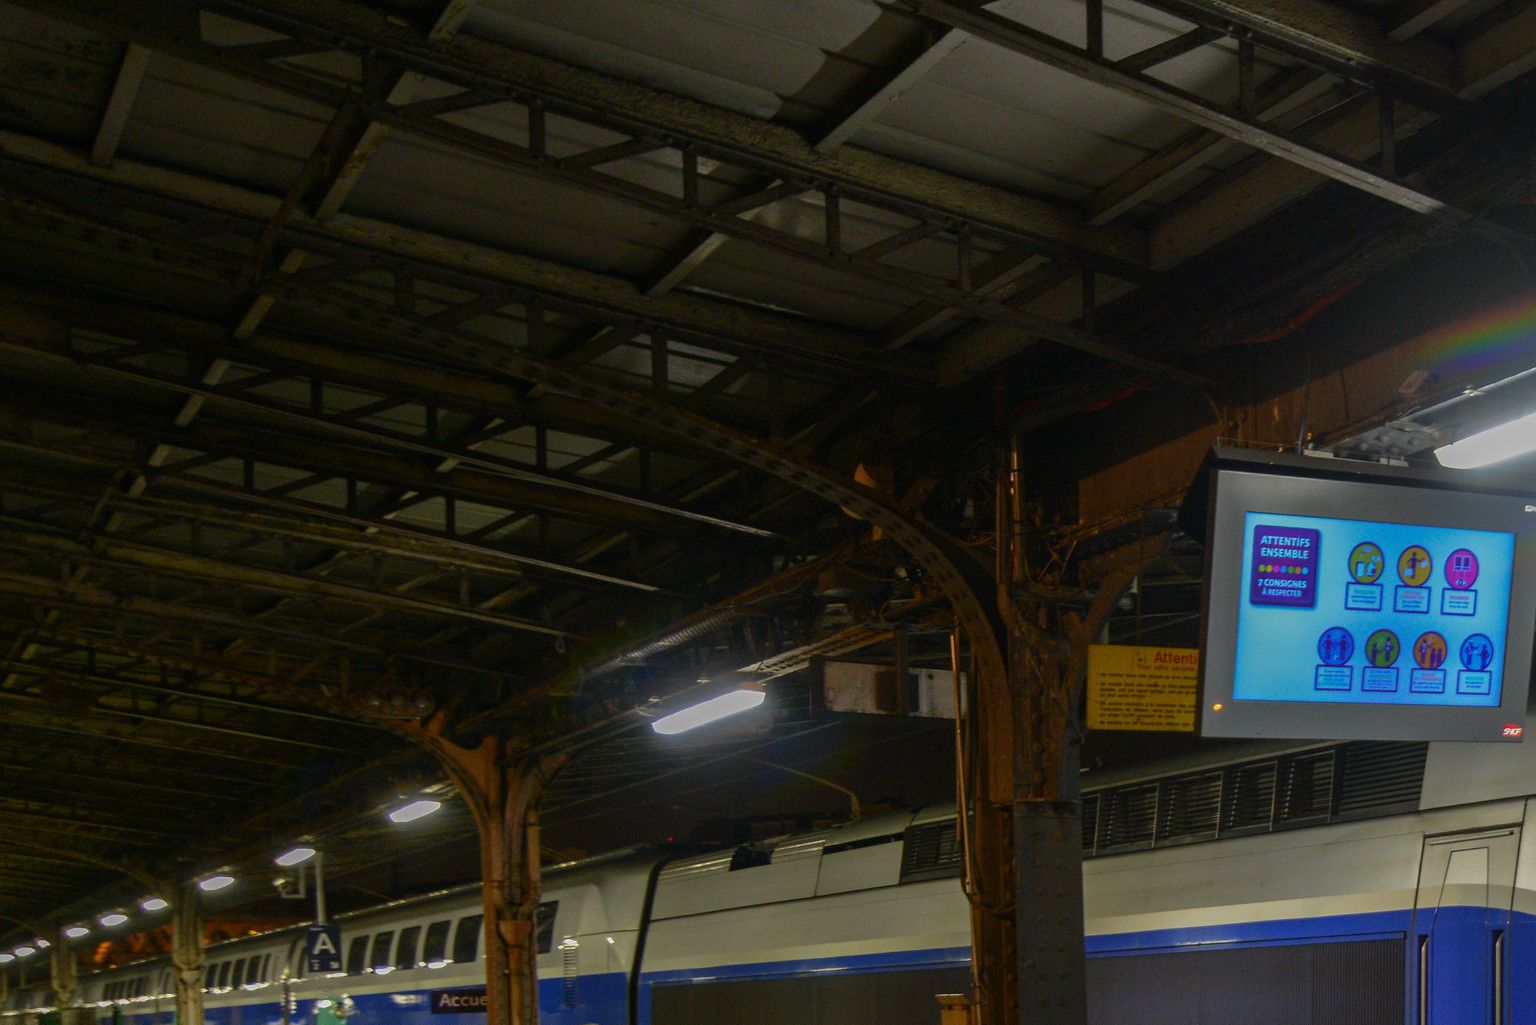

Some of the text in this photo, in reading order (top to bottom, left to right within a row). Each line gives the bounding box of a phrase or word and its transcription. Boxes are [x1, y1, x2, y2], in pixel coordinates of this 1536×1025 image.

[1260, 536, 1311, 547] ATTENTIFS
[1261, 547, 1309, 559] ENSEMBLE
[1263, 578, 1307, 588] CONSIGNES
[312, 932, 337, 954] A
